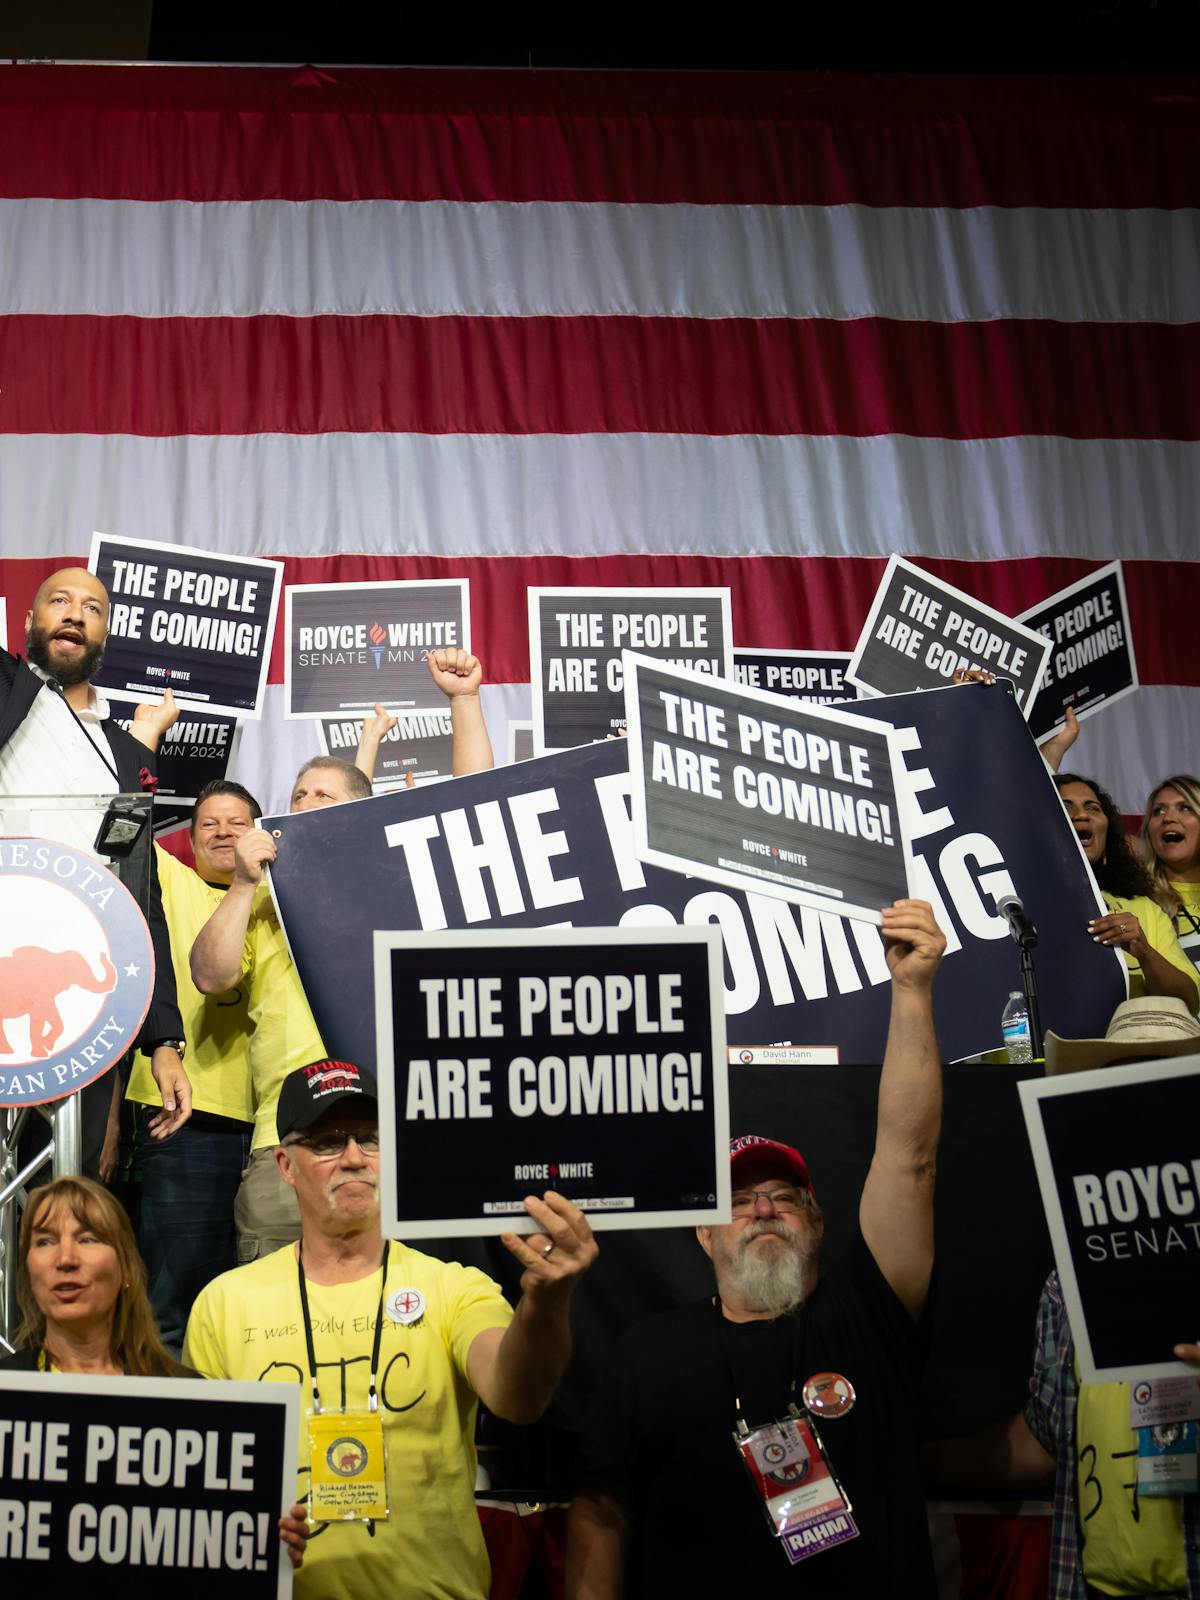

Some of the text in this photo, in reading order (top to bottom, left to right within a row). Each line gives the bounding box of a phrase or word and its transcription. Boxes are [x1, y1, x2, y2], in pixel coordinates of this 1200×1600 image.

[112, 560, 258, 613] THE PEOPLE
[108, 603, 261, 657] RE COMING!
[300, 622, 457, 650] ROYCE WHITE
[556, 613, 708, 648] THE PEOPLE
[875, 614, 925, 659] ARE
[899, 585, 943, 630] THE
[943, 611, 1028, 677] PEOPLE
[1054, 590, 1113, 645] PEOPLE
[299, 650, 414, 666] SENATE MN
[1055, 620, 1124, 680] COMING!
[146, 666, 190, 681] ROYCE WHITE
[548, 658, 598, 692] ARE
[735, 664, 760, 687] HE
[766, 666, 844, 691] PEOPLE
[165, 722, 229, 745] WHITE
[610, 719, 627, 728] ROYC
[659, 691, 873, 788] THE PEOPLE
[160, 745, 225, 759] MN 2024
[383, 758, 417, 768] ROYCE WHITE
[652, 741, 723, 800] ARE
[733, 766, 894, 846] COMING!
[384, 787, 585, 931] THE
[742, 839, 808, 866] ROYCE WHITE
[419, 973, 684, 1039] THE PEOPLE
[52, 1016, 125, 1085] PARTY
[763, 1050, 812, 1058] David Hann
[405, 1052, 704, 1120] ARE COMING!
[514, 1162, 594, 1180] ROYCE WHITE
[1085, 1221, 1200, 1263] SENAT
[243, 1327, 260, 1344] I
[264, 1322, 298, 1341] was
[85, 1424, 255, 1491] PEOPLE
[67, 1503, 270, 1571] COMING!
[788, 1515, 849, 1552] RAHM
